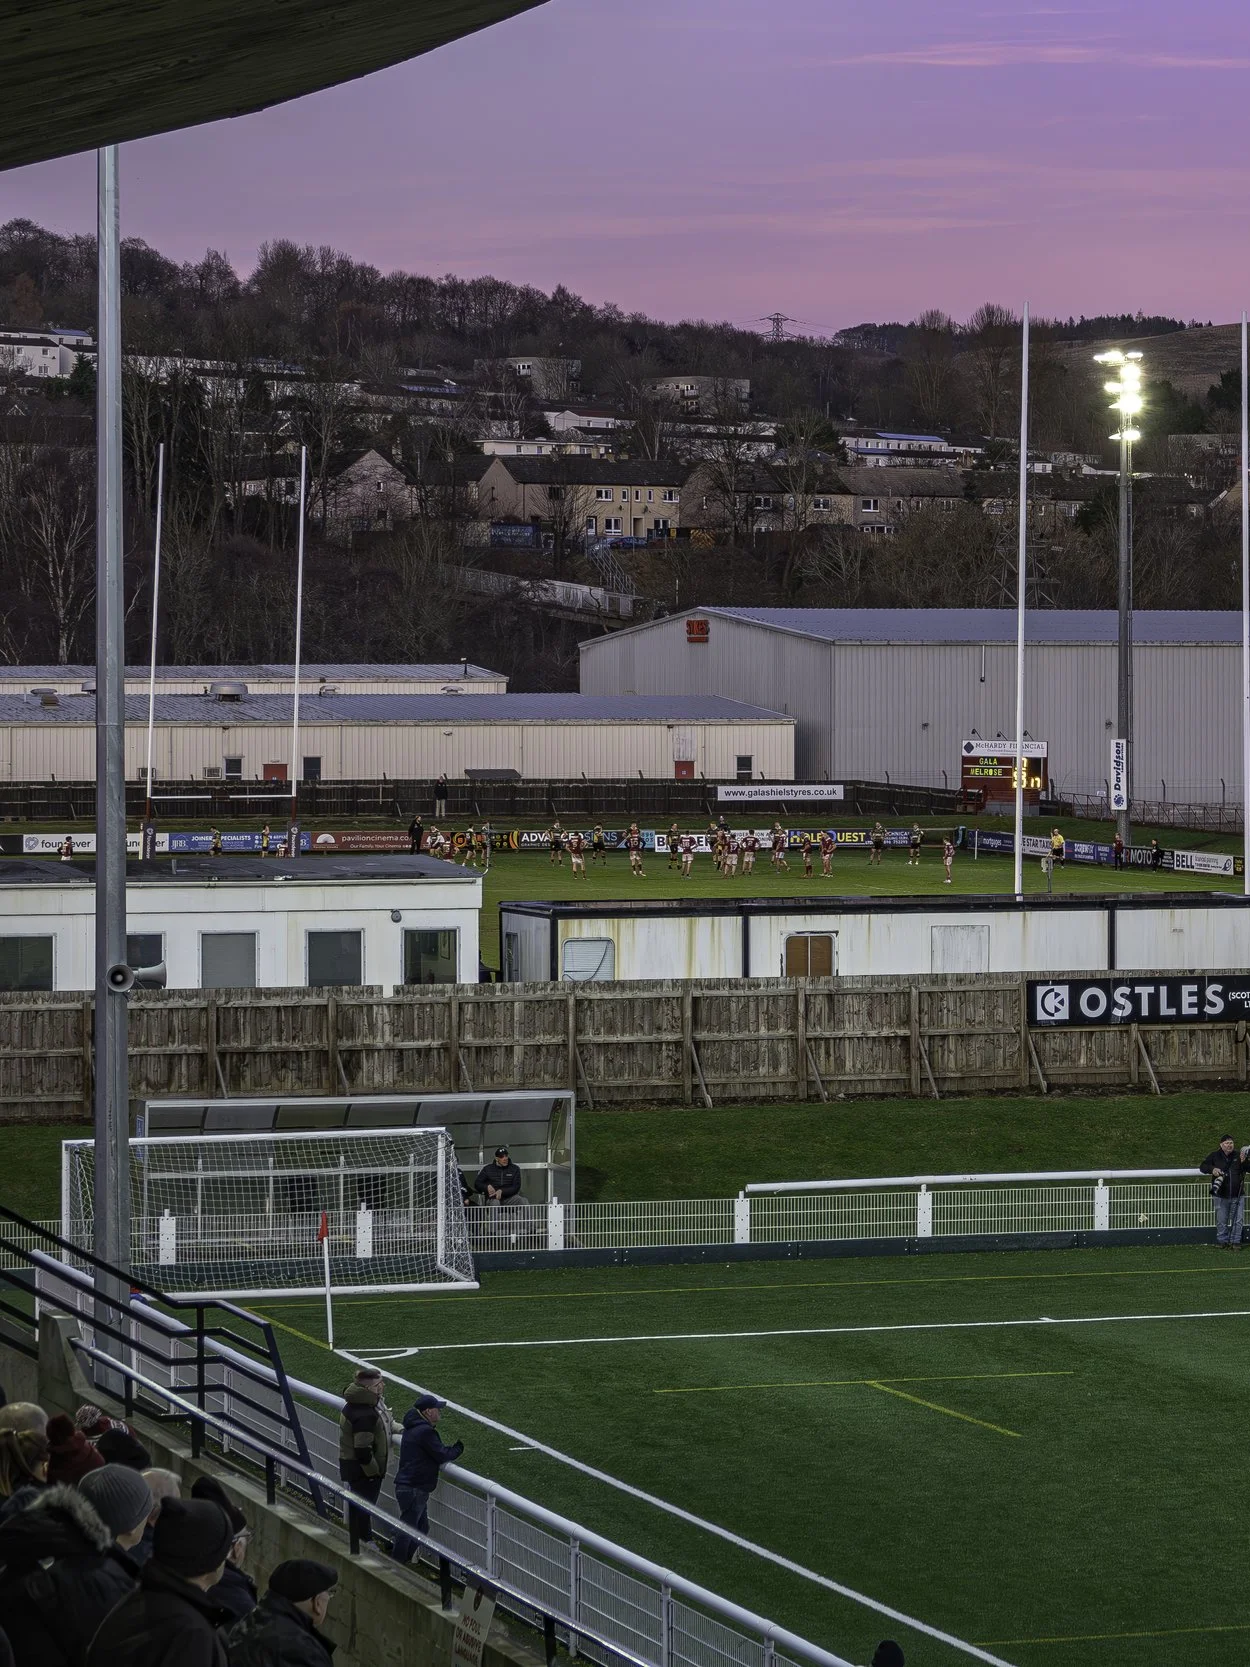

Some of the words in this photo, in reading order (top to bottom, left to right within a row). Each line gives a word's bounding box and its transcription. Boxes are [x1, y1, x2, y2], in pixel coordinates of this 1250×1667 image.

[1009, 742, 1045, 750] FINCIAL
[979, 757, 998, 766] GALA
[1113, 742, 1122, 791] Davidson
[970, 768, 1003, 776] MELROSE
[724, 787, 838, 798] www.galashielstyres.co.uk
[41, 839, 91, 848] founever
[982, 837, 1002, 848] mortgages
[1026, 838, 1040, 849] STAR
[1175, 853, 1195, 869] BELL
[1079, 983, 1225, 1018] OSTLES
